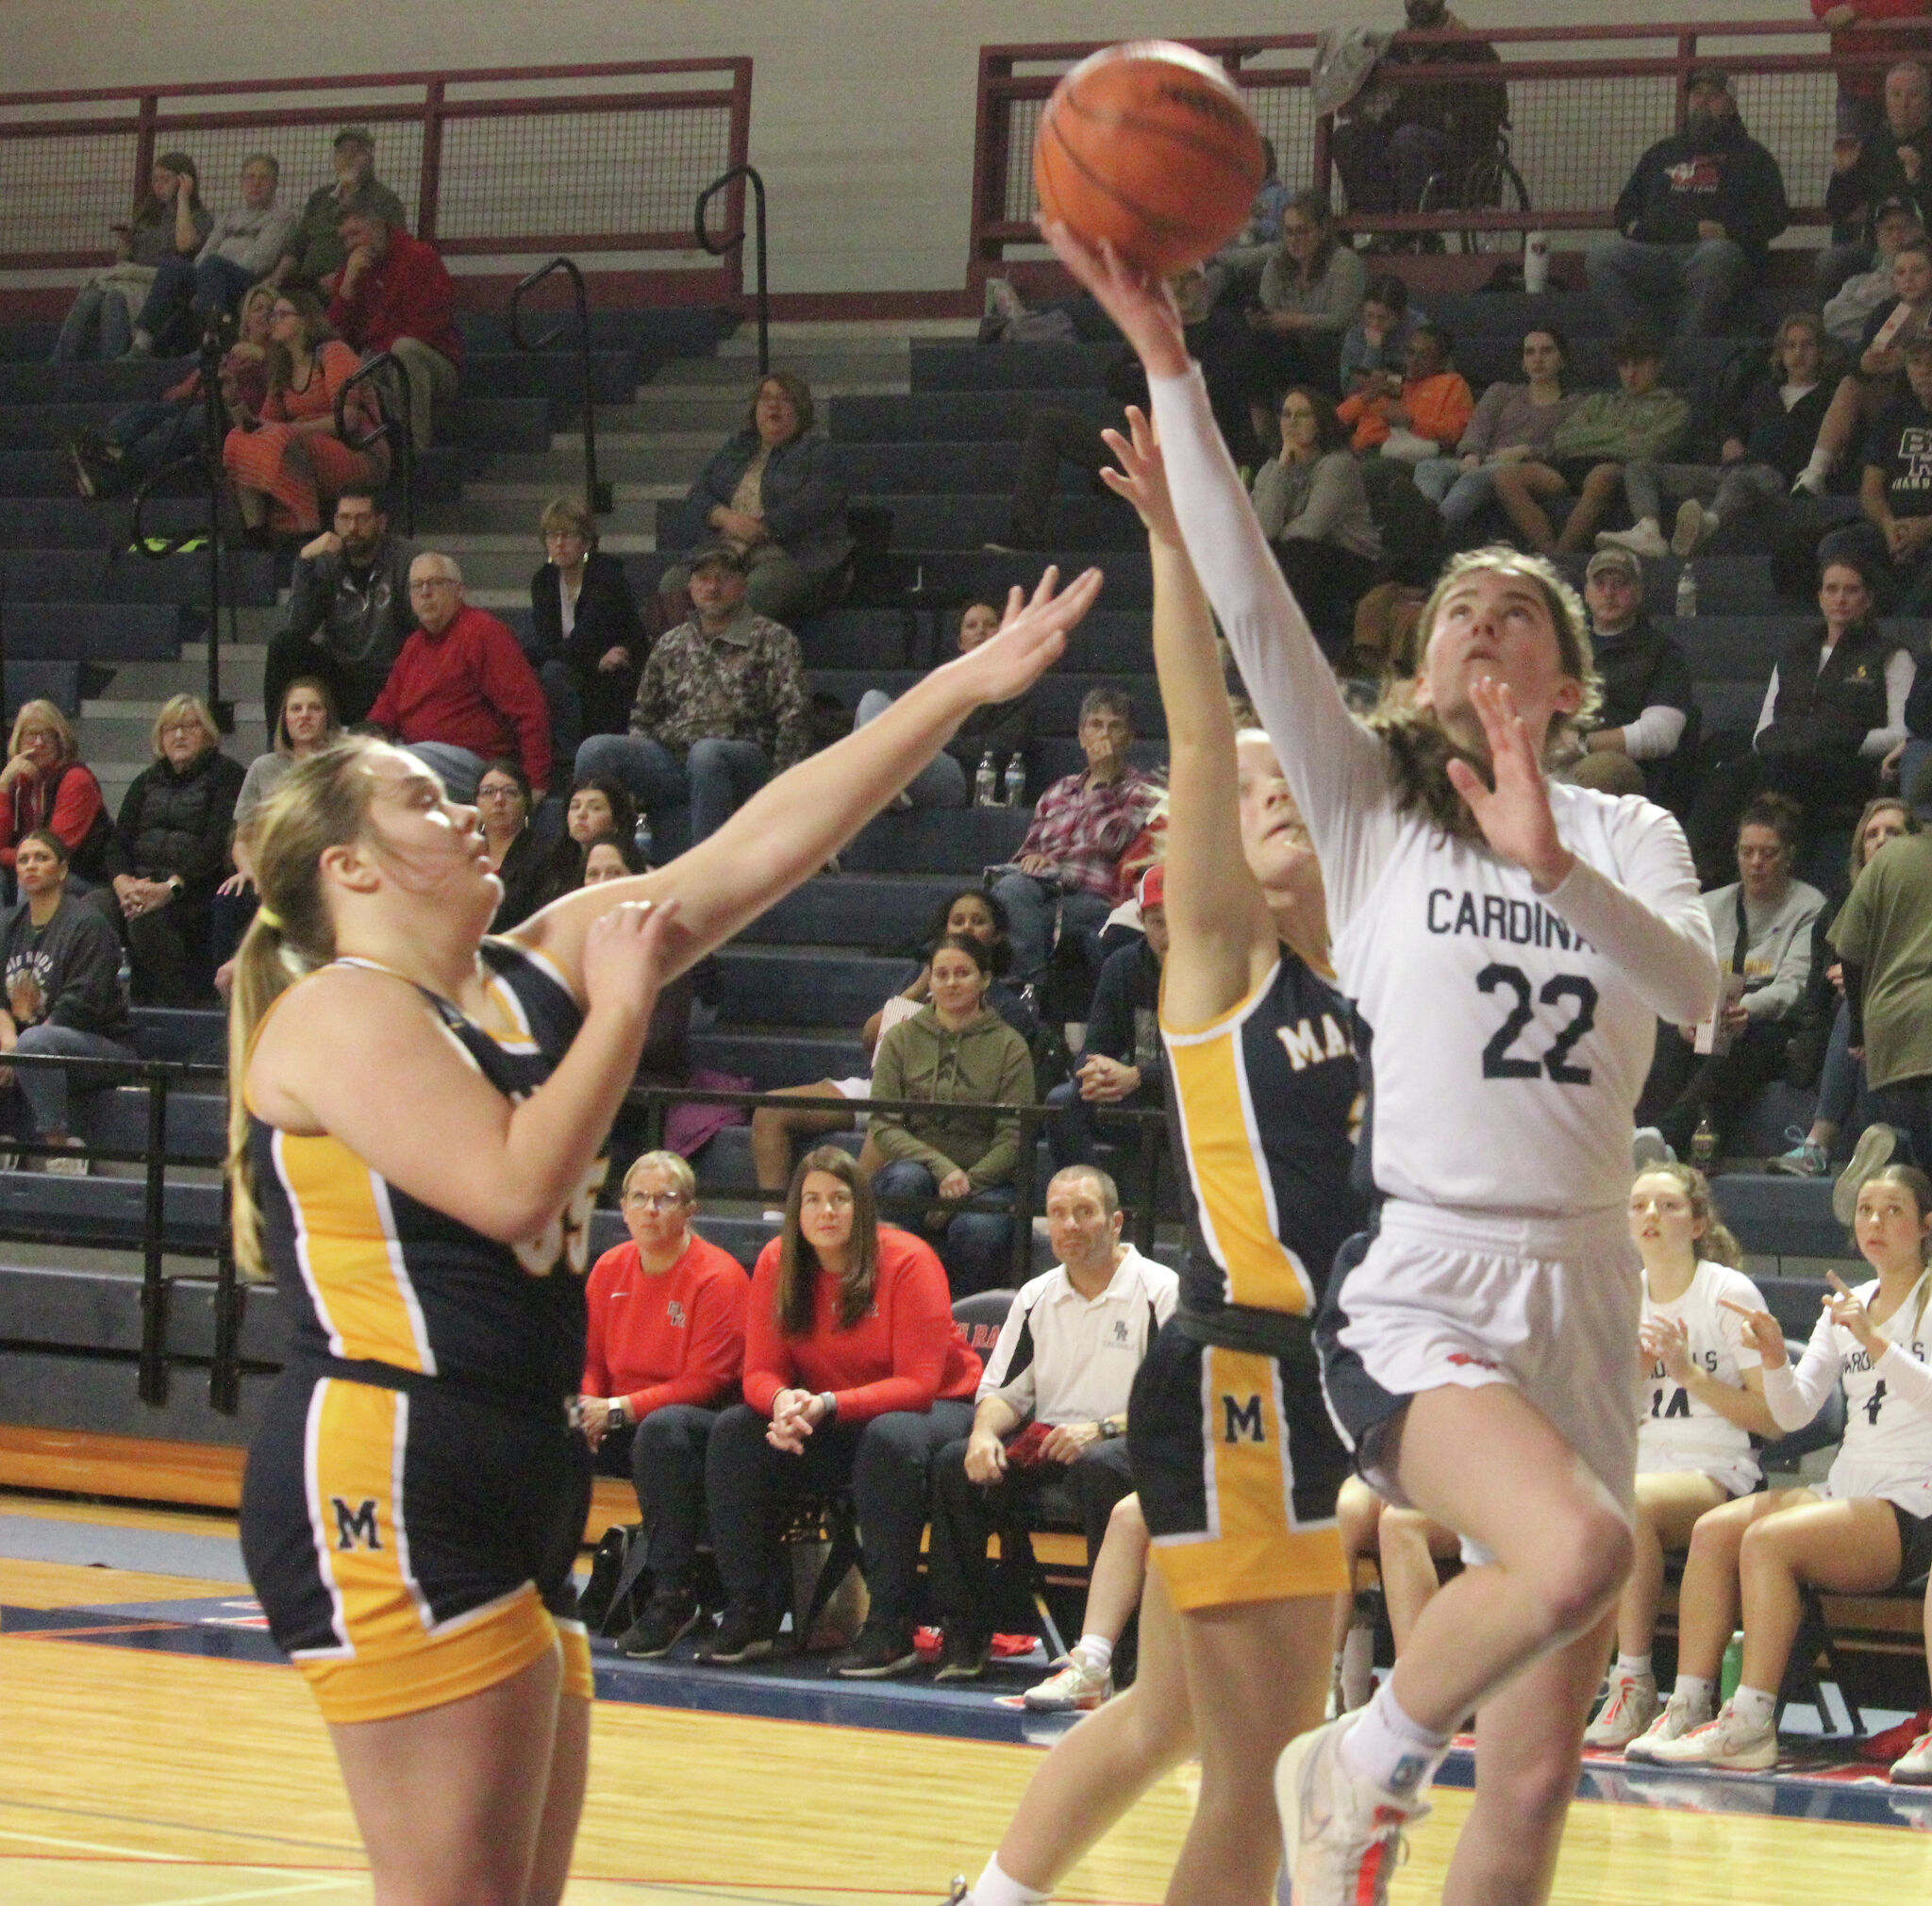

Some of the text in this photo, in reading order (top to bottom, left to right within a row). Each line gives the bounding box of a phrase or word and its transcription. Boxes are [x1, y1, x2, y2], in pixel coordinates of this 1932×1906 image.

[1476, 962, 1598, 1084] 22
[1222, 1395, 1265, 1444] M
[331, 1497, 384, 1550] M
